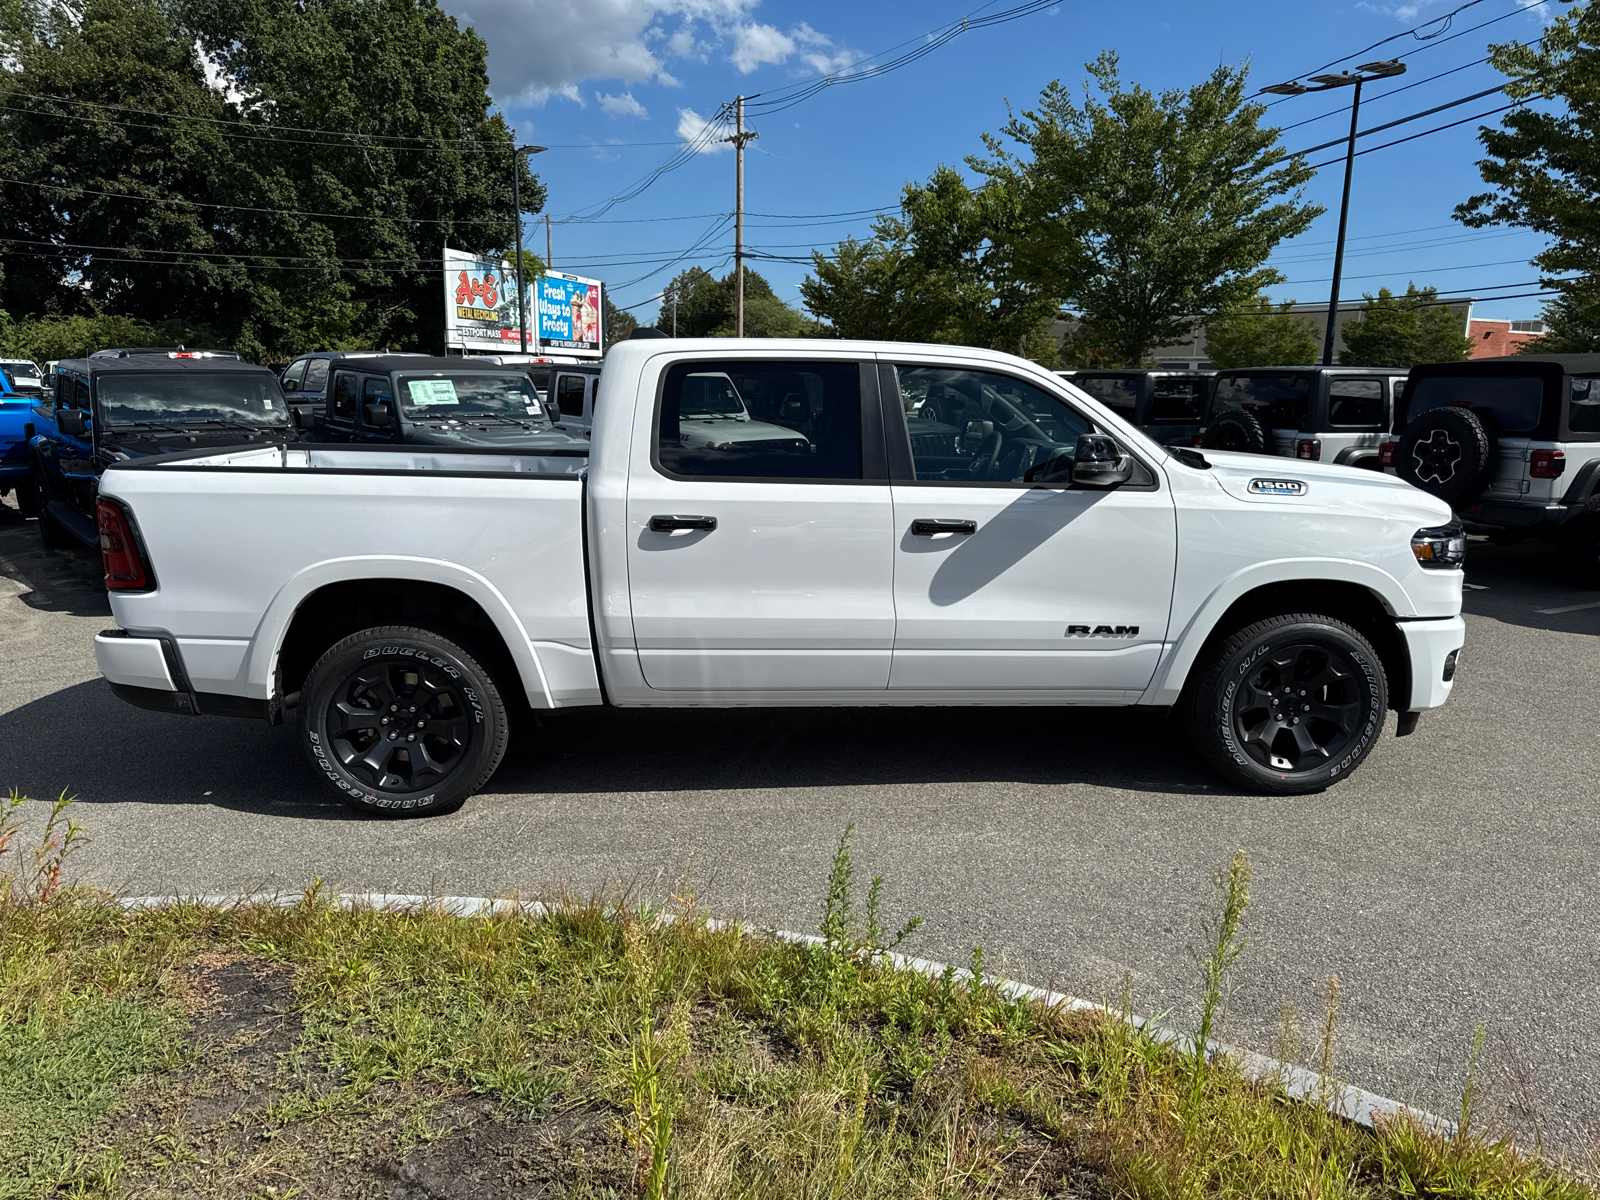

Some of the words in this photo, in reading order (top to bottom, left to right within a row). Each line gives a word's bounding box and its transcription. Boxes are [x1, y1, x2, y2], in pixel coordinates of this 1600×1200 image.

[456, 270, 498, 308] A&E
[544, 283, 566, 301] Fresh
[457, 307, 473, 319] METAL
[473, 309, 499, 322] RECYCLING
[540, 299, 561, 319] Ways
[562, 303, 571, 317] to
[487, 329, 502, 339] MASS
[543, 316, 569, 337] Frosty
[1255, 481, 1299, 490] 1500
[1067, 625, 1140, 635] RAM
[363, 646, 462, 679] DUELER
[463, 687, 484, 723] H/L
[1221, 681, 1248, 765] DUELER
[1239, 645, 1270, 675] H/L
[1330, 651, 1379, 777] BRIDGESTONE
[309, 730, 435, 808] BRIDGESTONE
